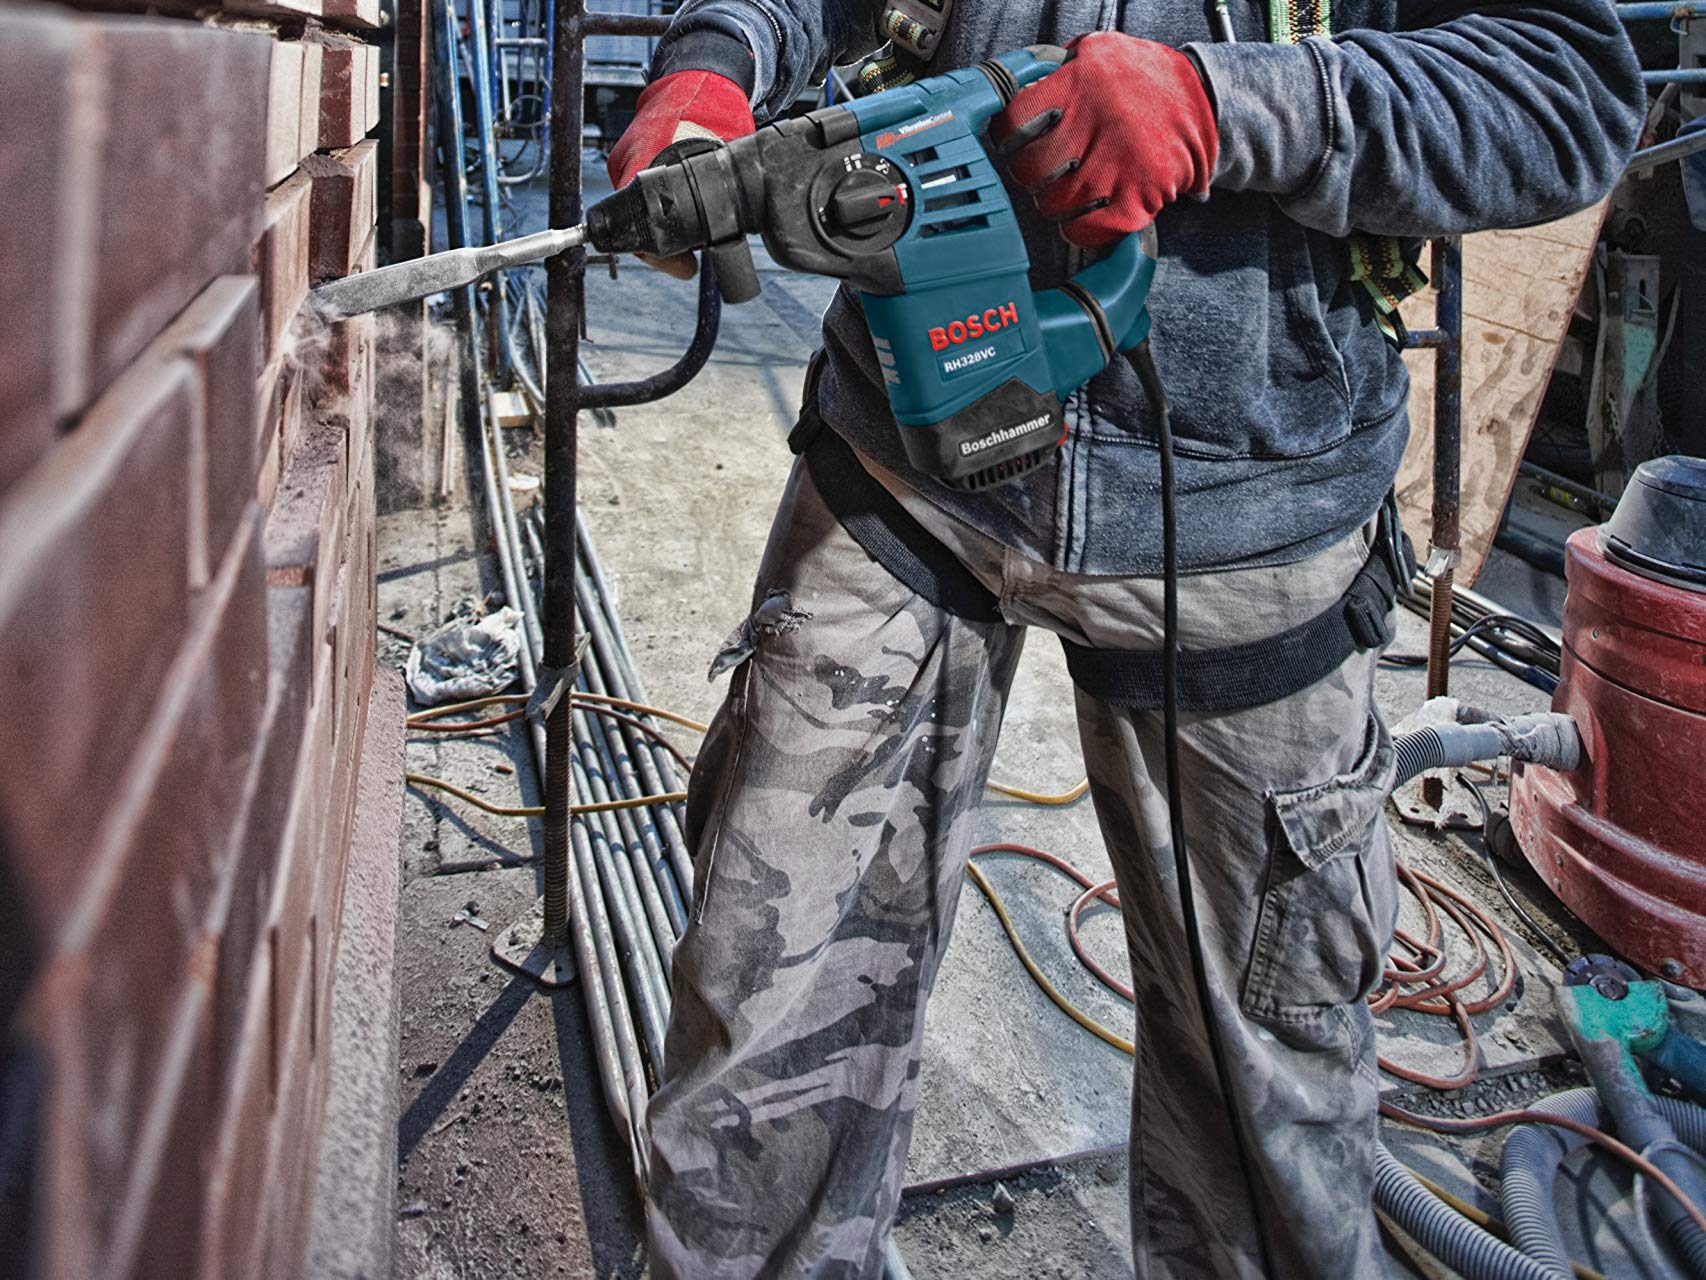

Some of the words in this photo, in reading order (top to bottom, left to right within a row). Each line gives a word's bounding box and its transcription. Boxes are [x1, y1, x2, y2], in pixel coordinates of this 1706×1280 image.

[928, 301, 1019, 352] BOSCH
[943, 345, 997, 374] RH328VC
[960, 413, 1051, 456] Boschhammer
